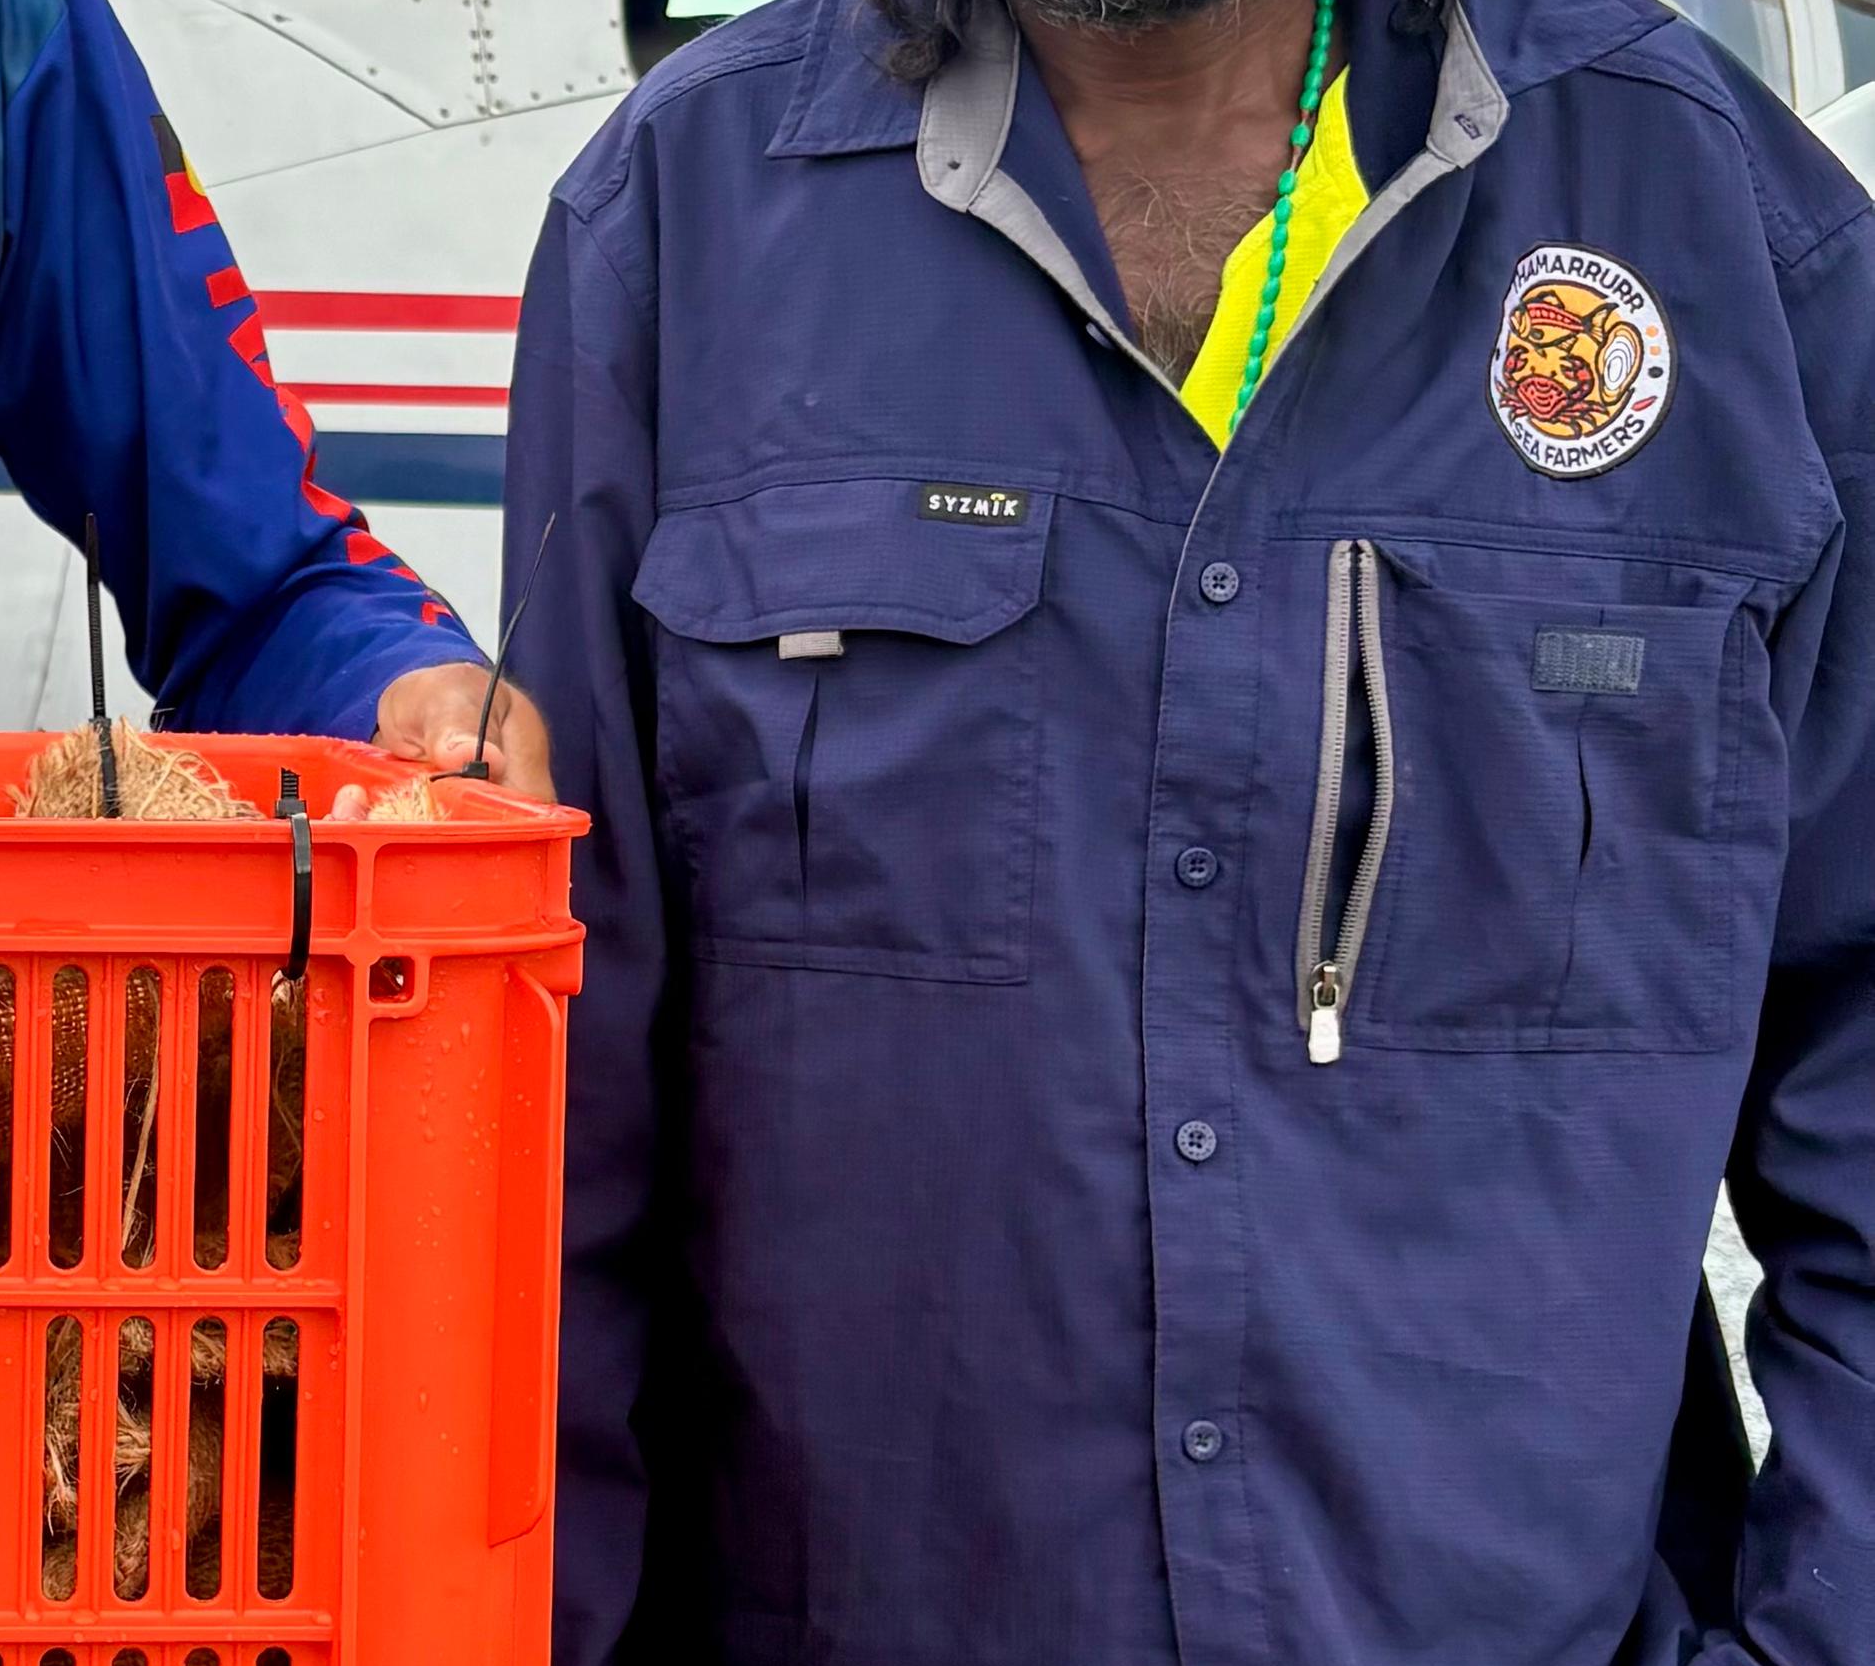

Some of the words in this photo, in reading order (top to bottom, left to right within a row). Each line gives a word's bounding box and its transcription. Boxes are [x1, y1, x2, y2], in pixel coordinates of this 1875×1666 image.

[1514, 420, 1541, 461] SEA
[1544, 413, 1646, 469] FARMERS
[928, 492, 1020, 517] SYZMIK
